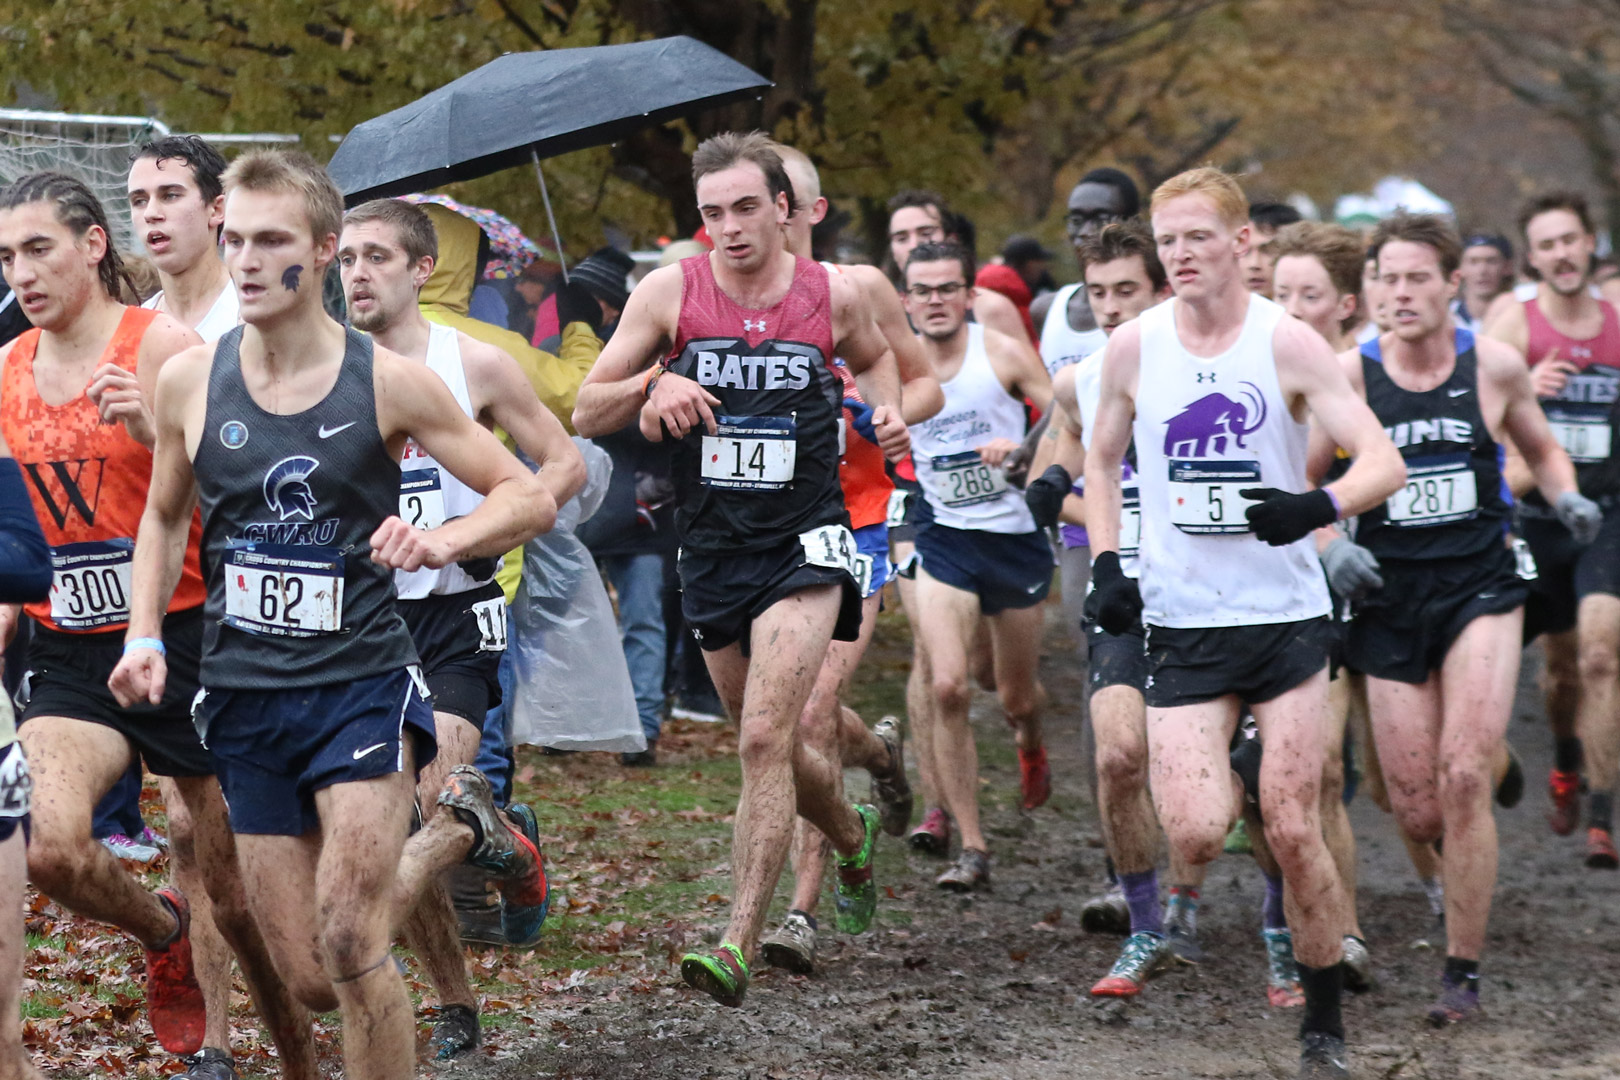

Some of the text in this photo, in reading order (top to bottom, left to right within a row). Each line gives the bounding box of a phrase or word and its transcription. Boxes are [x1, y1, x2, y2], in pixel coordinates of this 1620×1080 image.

[696, 351, 810, 391] BATES
[1557, 374, 1618, 403] ATES
[731, 441, 765, 478] 14
[23, 457, 107, 531] W
[949, 466, 994, 498] 268
[1407, 478, 1454, 514] 287
[1209, 486, 1222, 522] 5
[244, 518, 340, 545] CWRU
[819, 530, 851, 566] 14
[264, 557, 289, 566] COUNTRY
[290, 560, 336, 570] CHAMPIONS
[61, 569, 126, 616] 300
[260, 574, 303, 624] 62
